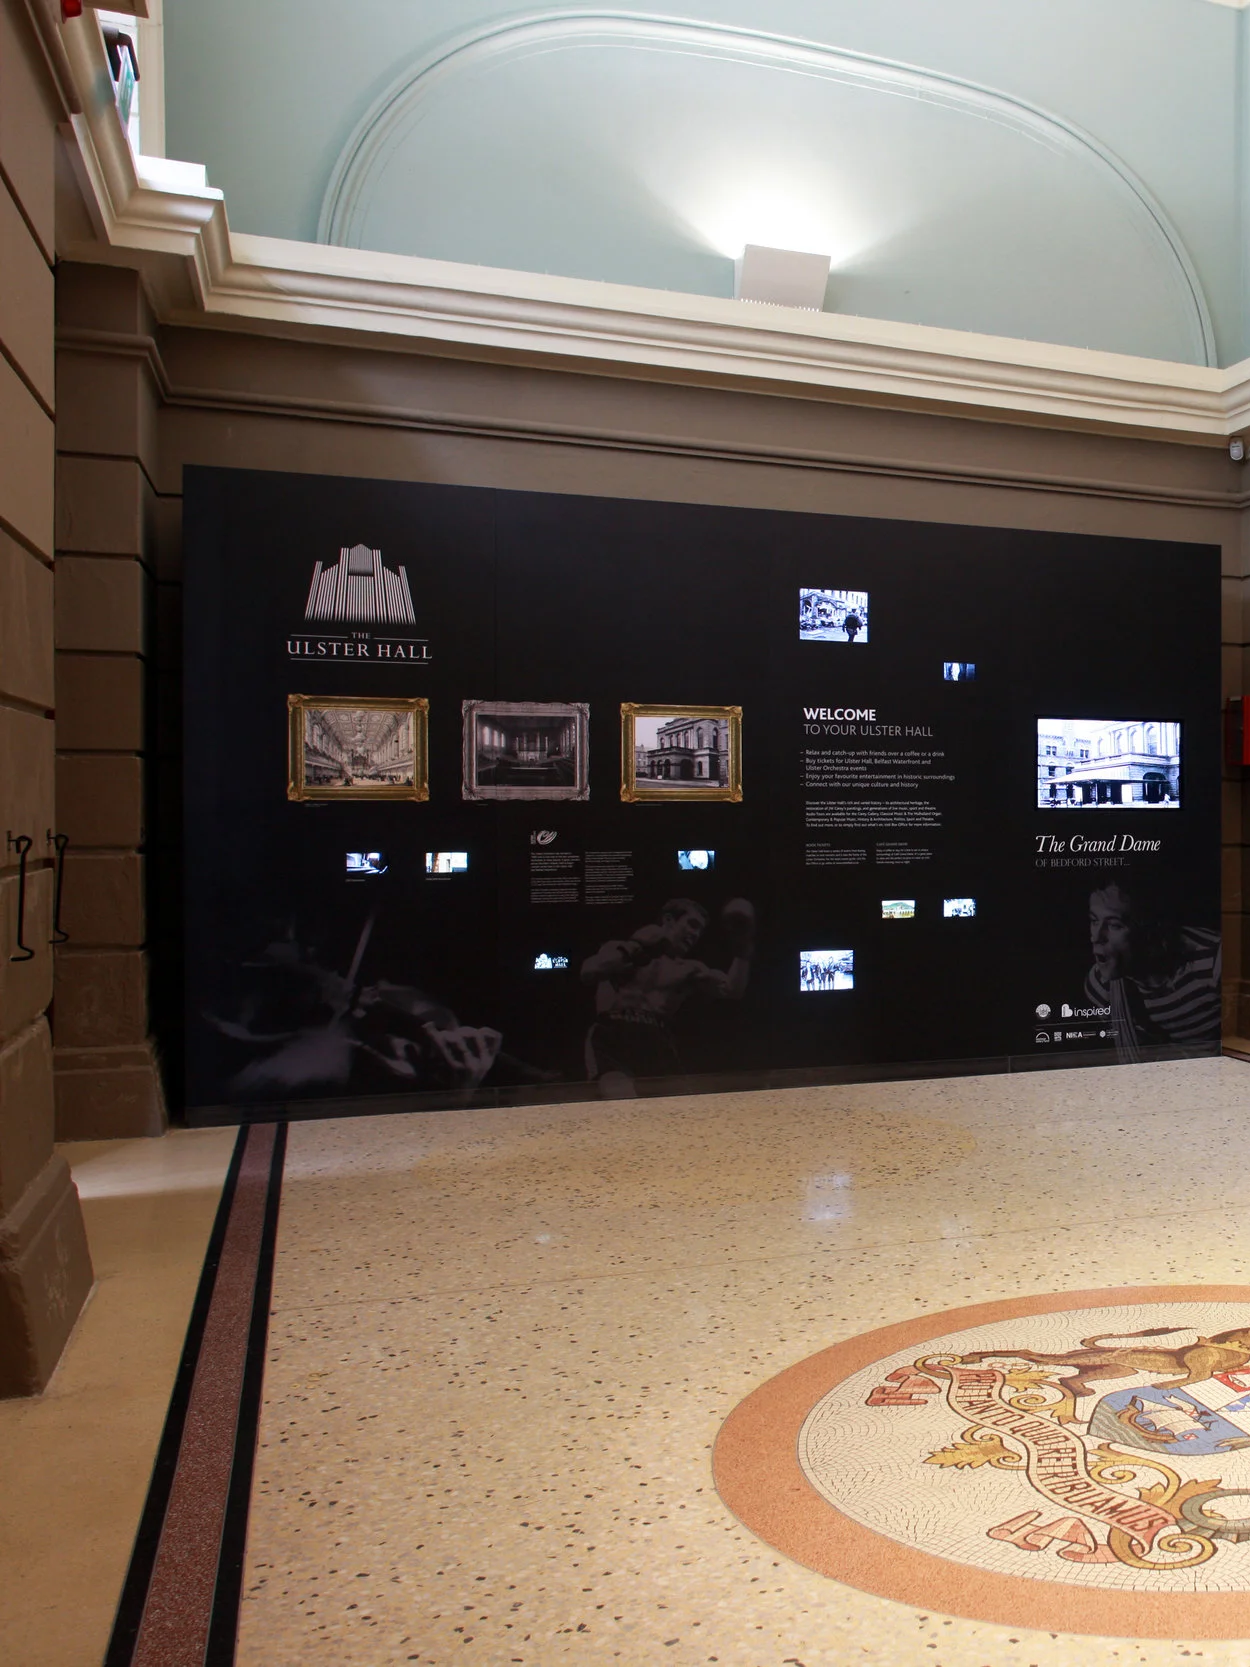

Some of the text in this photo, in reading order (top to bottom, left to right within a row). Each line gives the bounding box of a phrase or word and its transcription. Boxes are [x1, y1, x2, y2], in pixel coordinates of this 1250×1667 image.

[287, 641, 432, 659] ULSTER HALL
[803, 708, 876, 721] WELCOME
[804, 724, 933, 737] TO YOUR ULSTER HALL
[1035, 835, 1161, 852] The Grand Dame
[1035, 859, 1048, 867] OF
[1051, 858, 1091, 867] BEDFORD
[1074, 1006, 1111, 1018] inspired
[956, 1392, 1025, 1426] TANTO
[1010, 1421, 1070, 1446] QUID
[1037, 1448, 1168, 1531] RETRIBUAMUS
